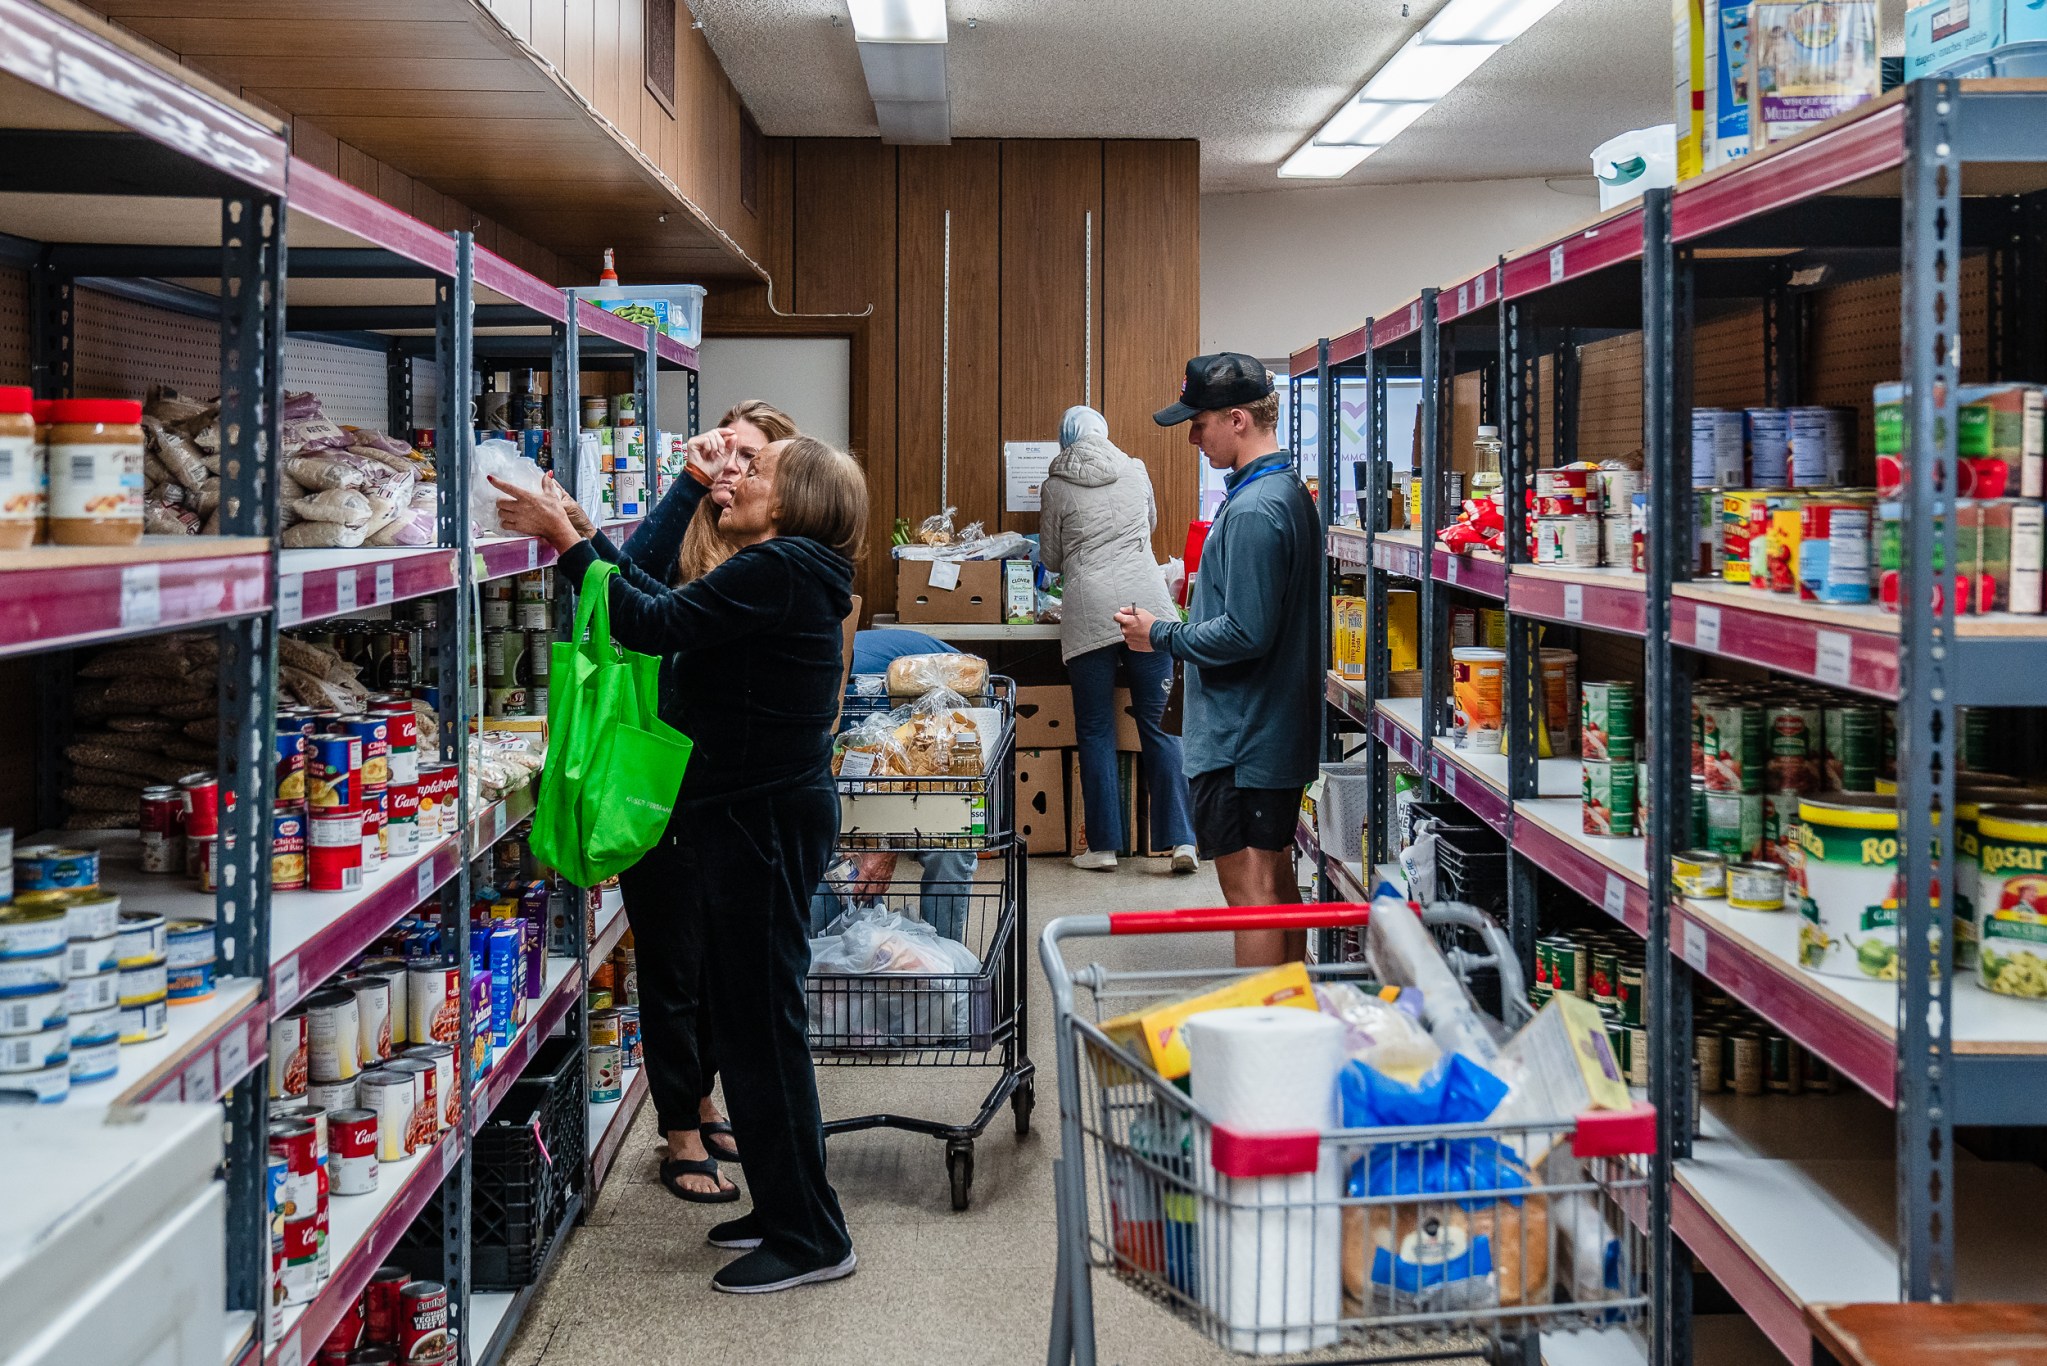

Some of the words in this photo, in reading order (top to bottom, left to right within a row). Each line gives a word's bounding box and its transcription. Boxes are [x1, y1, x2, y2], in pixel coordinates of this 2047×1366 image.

[273, 838, 304, 847] Chicken
[273, 845, 290, 853] and
[290, 844, 304, 852] Rice
[415, 1321, 436, 1331] BEEF
